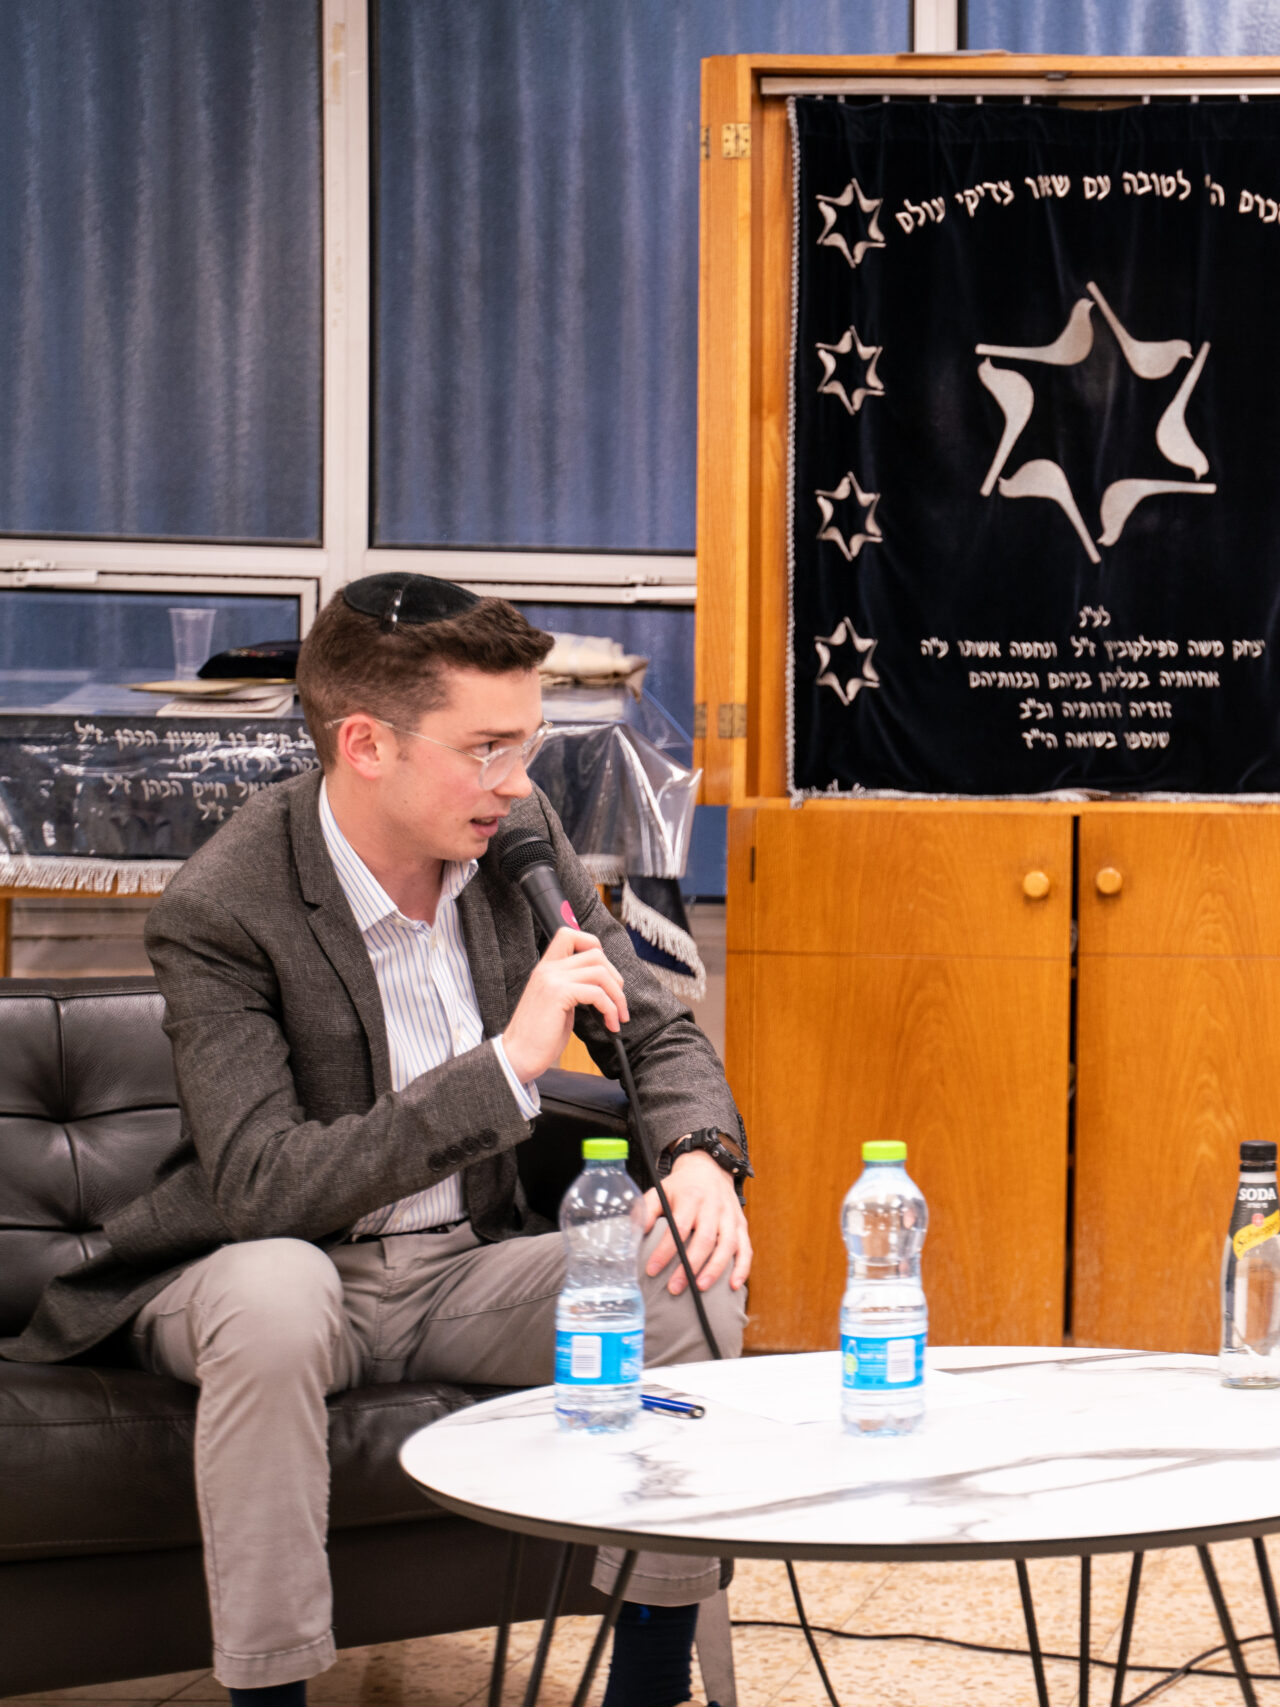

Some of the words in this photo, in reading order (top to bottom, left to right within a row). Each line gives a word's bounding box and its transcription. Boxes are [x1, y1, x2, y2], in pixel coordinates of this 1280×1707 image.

[1025, 175, 1070, 199] שאר
[1083, 175, 1111, 200] עם
[1123, 170, 1191, 200] לטובה
[1205, 174, 1225, 206] ה'
[955, 181, 1014, 216] צדיקי
[896, 197, 945, 233] עולם
[921, 637, 948, 658] ע"ה
[958, 640, 1001, 657] אשתו
[1010, 641, 1057, 658] ונחמה
[1071, 636, 1096, 657] ז"ל
[1188, 640, 1224, 657] משה
[1233, 640, 1265, 660] יצחק
[969, 671, 1039, 688] ובנותיהם
[1048, 672, 1092, 689] בניהם
[1099, 666, 1150, 692] בעליהן
[1160, 671, 1220, 687] אחיותיה
[1020, 698, 1053, 719] וב"ב
[74, 720, 104, 744] ז"ל
[114, 728, 158, 752] הכהן
[1065, 732, 1117, 748] בשואה
[103, 772, 132, 795] ז"ל
[141, 779, 184, 802] הכהן
[192, 781, 228, 799] חיים
[1238, 1188, 1277, 1201] SODA
